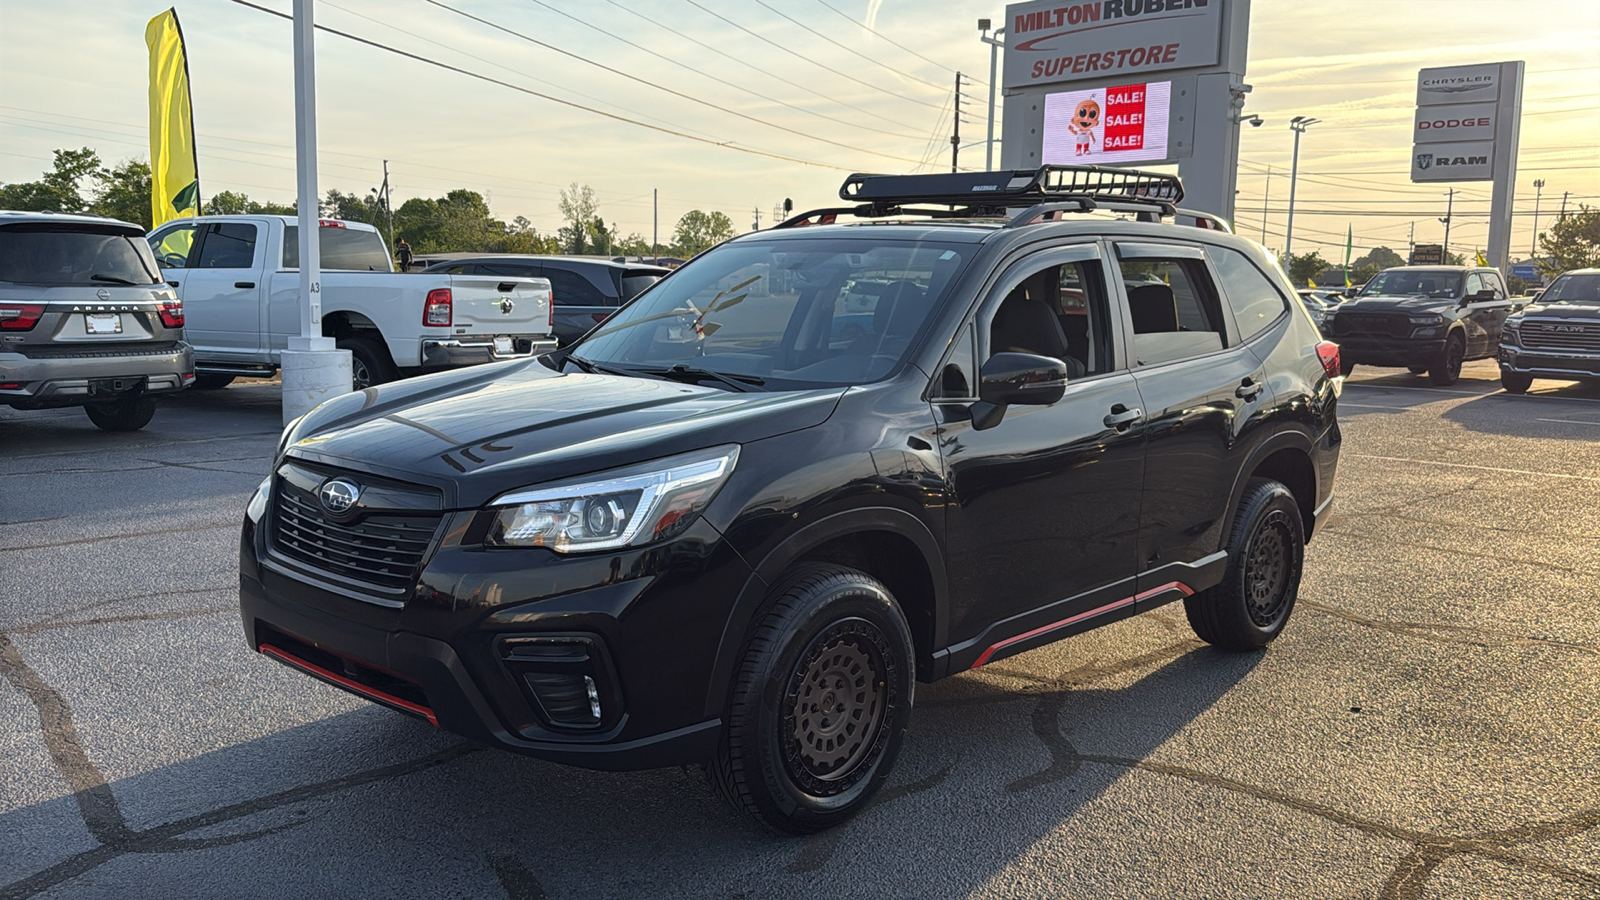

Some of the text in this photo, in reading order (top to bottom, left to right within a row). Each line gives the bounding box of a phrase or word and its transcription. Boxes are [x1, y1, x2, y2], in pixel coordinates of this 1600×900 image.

[1014, 2, 1101, 34] MILTON
[1031, 43, 1180, 79] SUPERSTORE
[1423, 76, 1492, 86] CHRYSLER
[1107, 92, 1144, 105] SALE!
[1106, 113, 1143, 127] SALE!
[1418, 117, 1491, 130] DODGE
[1104, 135, 1141, 148] SALE!
[1436, 156, 1487, 166] RAM
[310, 282, 320, 294] A3
[1541, 325, 1585, 333] RAM
